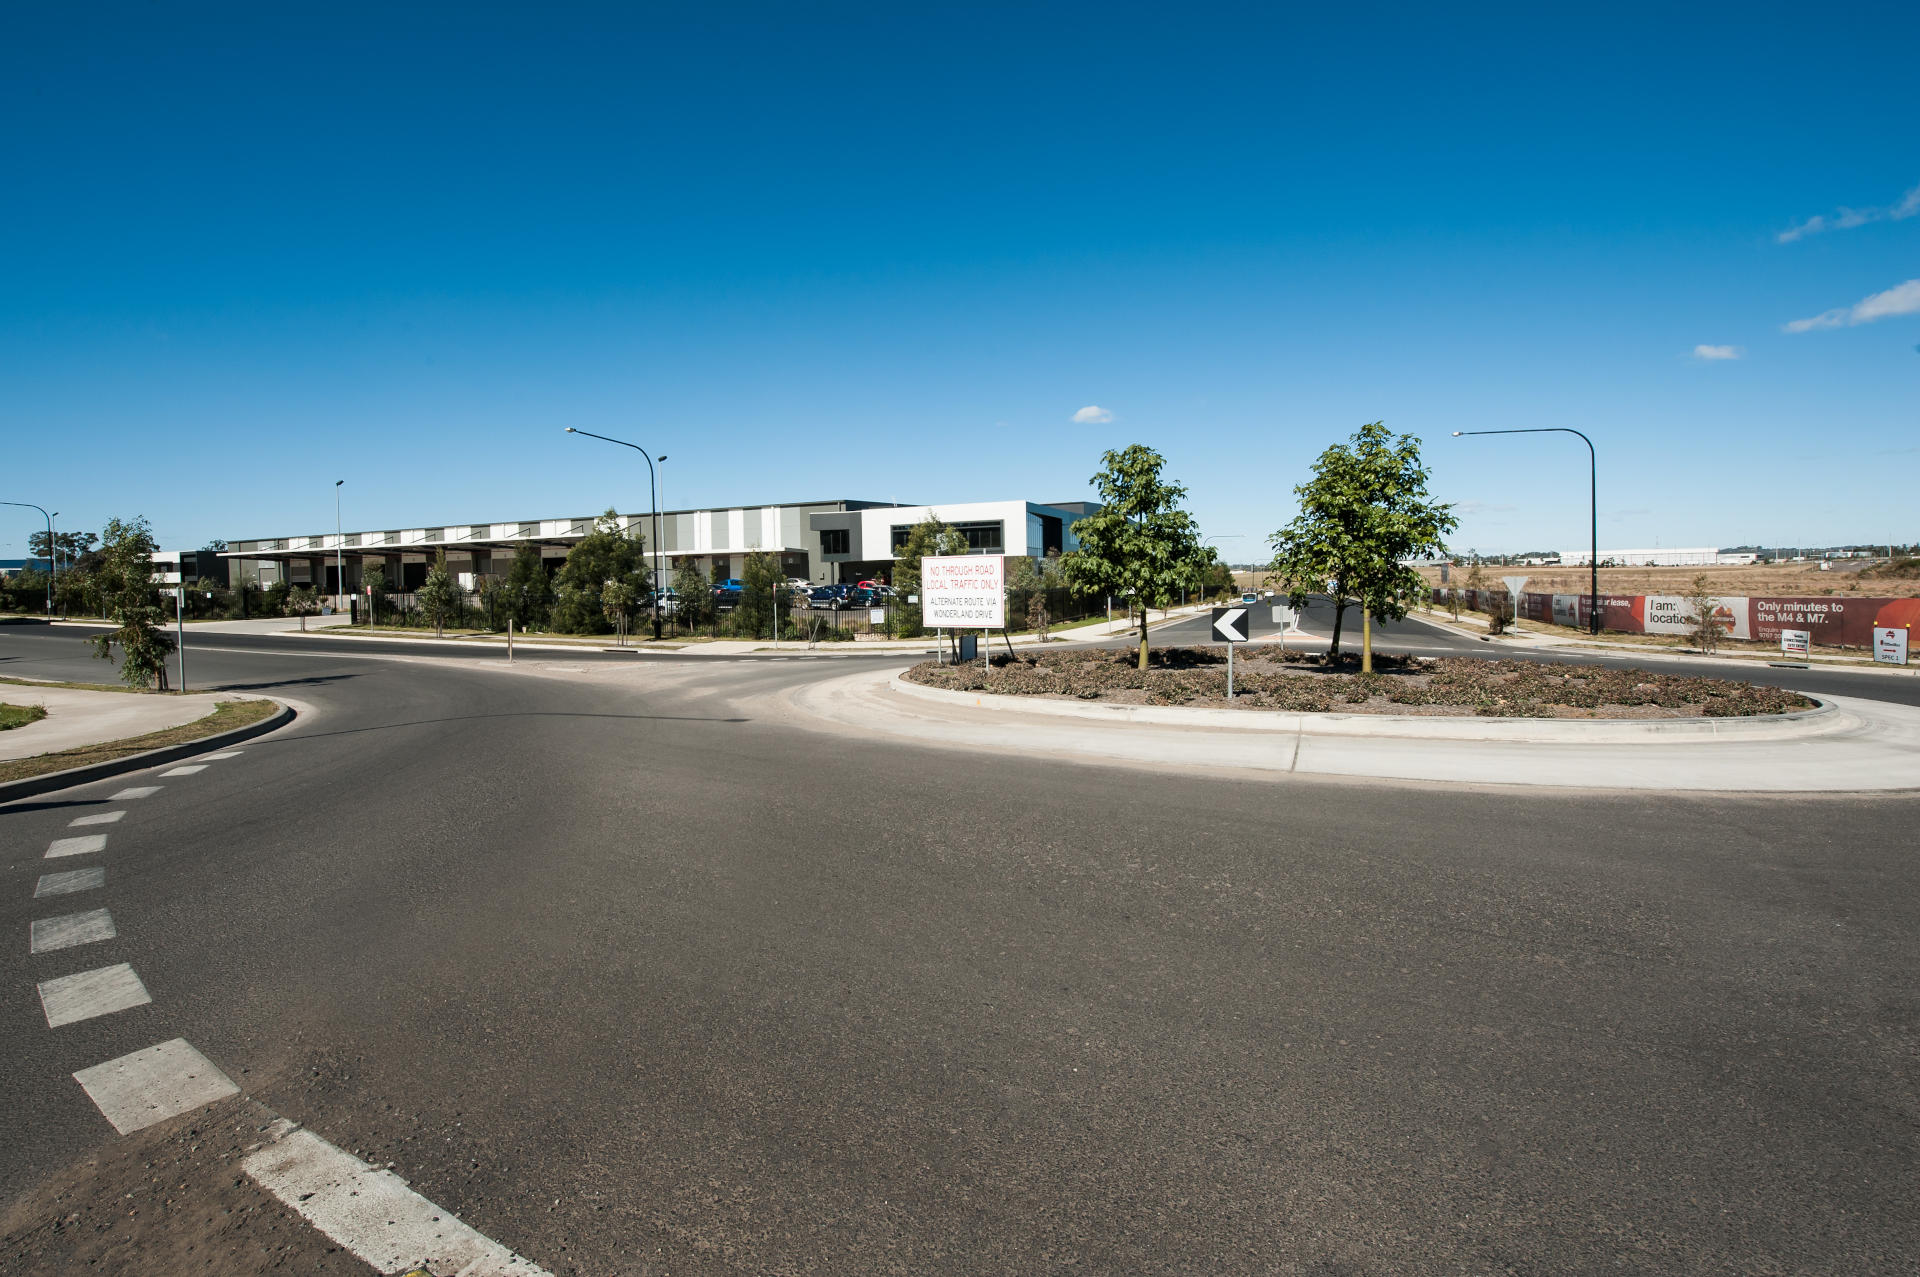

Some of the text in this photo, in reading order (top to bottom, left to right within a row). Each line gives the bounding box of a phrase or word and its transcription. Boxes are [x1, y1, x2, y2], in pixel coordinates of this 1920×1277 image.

[930, 564, 994, 576] NO THROUGH ROAD
[927, 579, 998, 590] LOCAL TRAFFIC ONLY
[930, 597, 996, 606] ALTERNATE ROUTE VIA
[1611, 598, 1631, 608] lease,
[1650, 599, 1676, 611] I am:
[1757, 601, 1844, 613] Only minutes to
[934, 609, 993, 619] WONDERLAND DRIVE
[1650, 612, 1689, 624] locatio
[1757, 612, 1829, 624] the M4 & M7.
